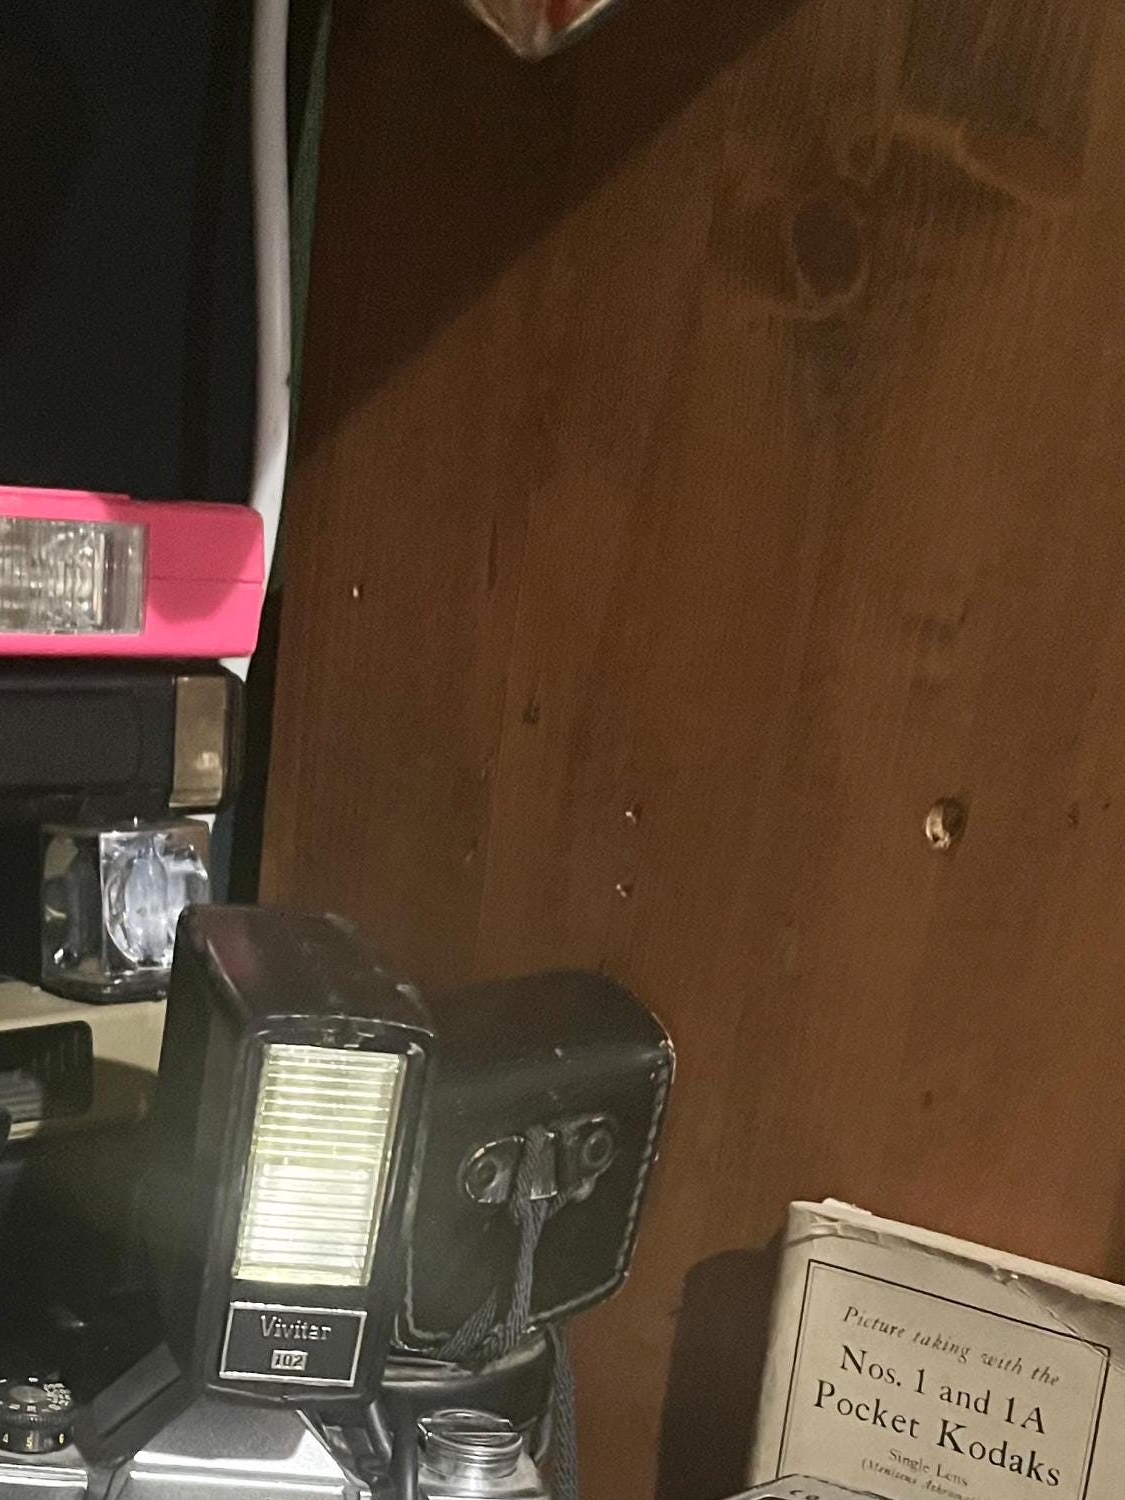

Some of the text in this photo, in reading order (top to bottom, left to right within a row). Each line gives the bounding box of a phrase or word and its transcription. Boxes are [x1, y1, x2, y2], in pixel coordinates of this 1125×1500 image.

[261, 1315, 331, 1340] Vivitar
[843, 1306, 1060, 1386] Picture taking with the
[275, 1354, 303, 1367] 102
[839, 1344, 1046, 1435] Nos. 1 and 1A
[813, 1379, 1061, 1487] Pocket Kodaks
[888, 1448, 969, 1488] Single Lens
